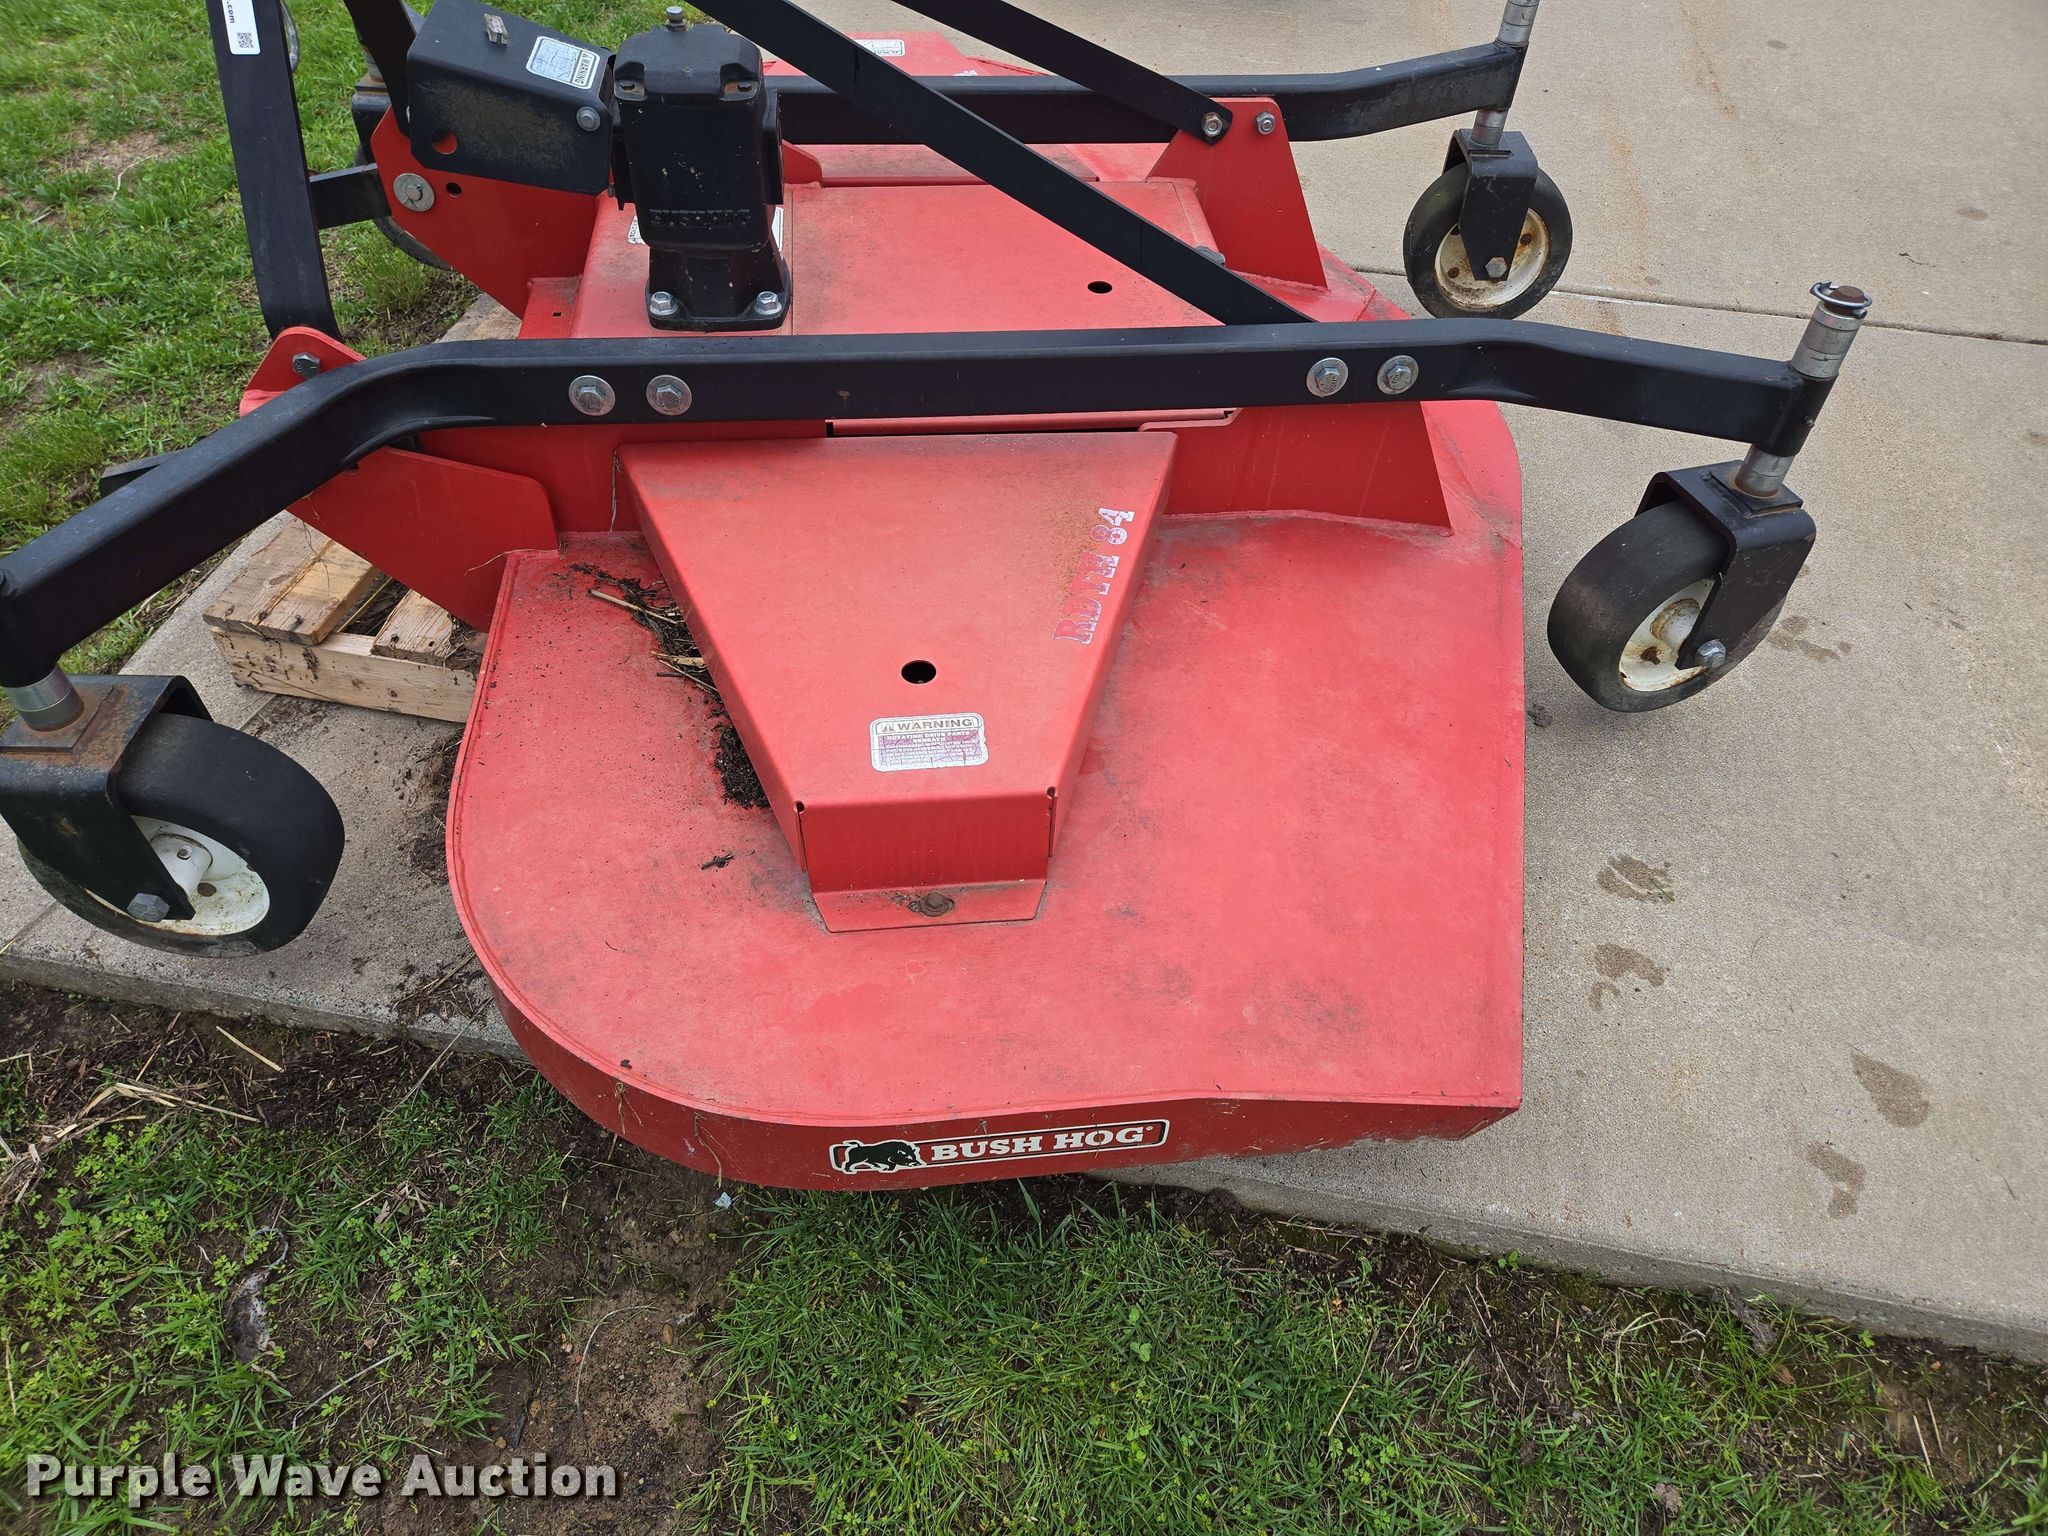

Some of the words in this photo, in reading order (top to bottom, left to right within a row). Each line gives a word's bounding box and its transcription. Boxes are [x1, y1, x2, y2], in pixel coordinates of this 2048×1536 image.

[227, 0, 235, 23] .com
[1091, 508, 1135, 545] 84
[897, 718, 973, 732] WARNING
[931, 1135, 1043, 1161] BUSH
